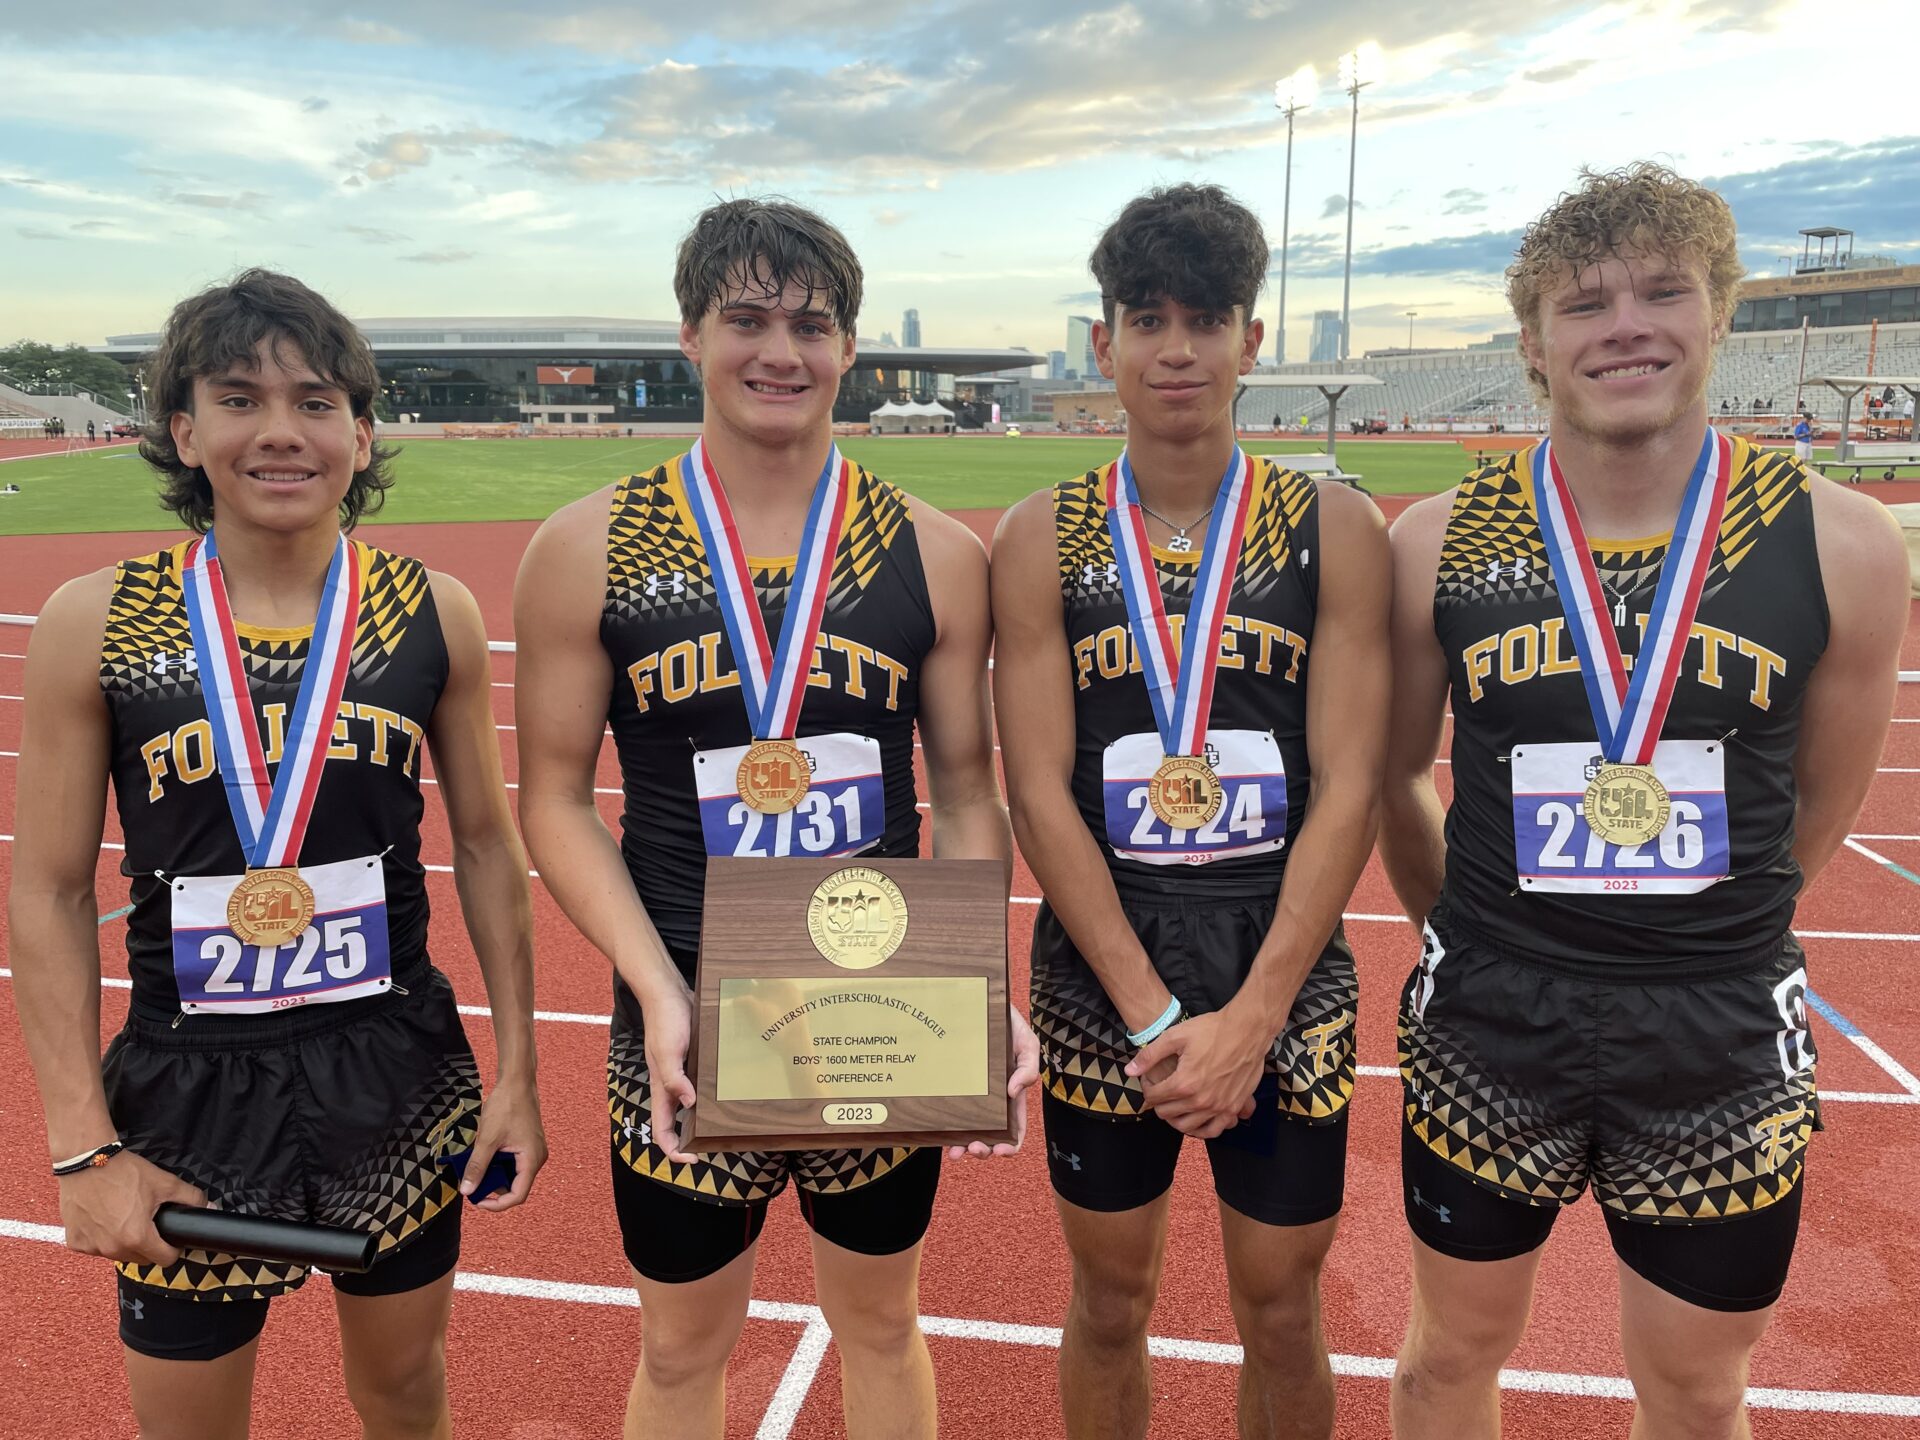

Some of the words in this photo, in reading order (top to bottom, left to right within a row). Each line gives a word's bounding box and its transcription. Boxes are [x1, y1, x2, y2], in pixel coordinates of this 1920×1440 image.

[627, 631, 908, 713] FOLETT
[760, 790, 788, 798] STATE
[1162, 779, 1207, 805] UIL
[1172, 805, 1200, 814] STATE
[1608, 819, 1643, 829] STATE
[1184, 853, 1213, 863] 2023
[1603, 880, 1639, 891] 2023
[255, 921, 289, 931] STATE
[838, 935, 878, 947] STATE
[272, 996, 306, 1009] 2023
[761, 1000, 818, 1043] UNIVERSITY
[819, 992, 912, 1014] INTERSCHOLASTIC
[911, 1009, 947, 1039] LEAGUE
[813, 1036, 842, 1046] STATE
[844, 1036, 897, 1046] CHAMPION
[793, 1055, 823, 1065] BOYS'
[826, 1055, 847, 1064] 1600
[850, 1055, 883, 1064] METER
[886, 1054, 916, 1064] RELAY
[816, 1073, 884, 1083] CONFERENCE
[885, 1073, 893, 1082] A
[837, 1107, 873, 1120] 2023
